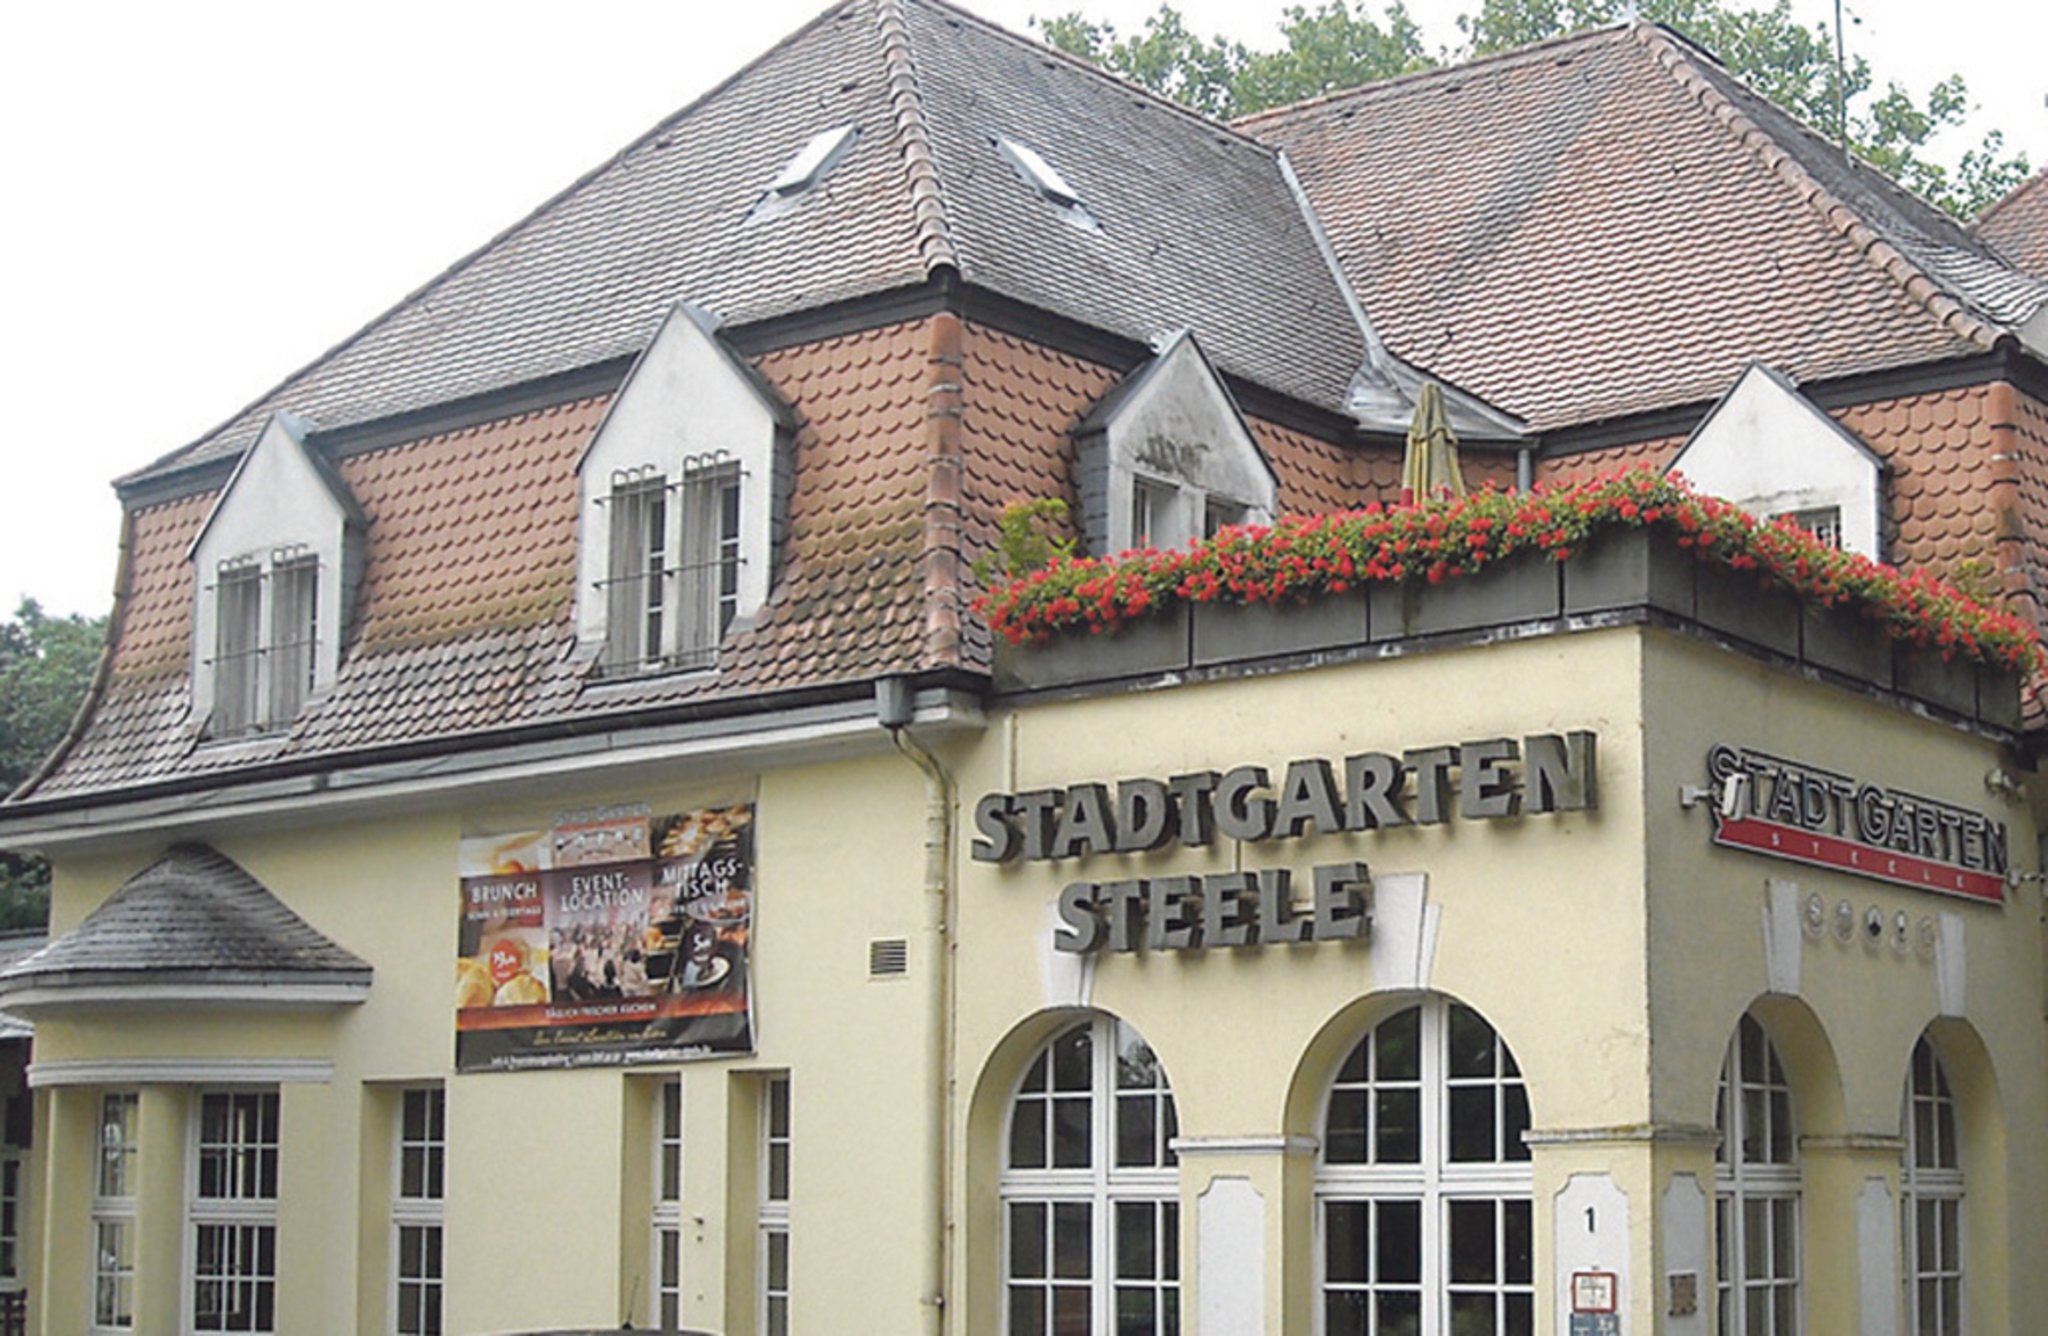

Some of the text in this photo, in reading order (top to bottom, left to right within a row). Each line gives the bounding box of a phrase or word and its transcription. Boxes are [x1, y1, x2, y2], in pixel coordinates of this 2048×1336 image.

[971, 730, 1596, 862] STADTGARTEN
[1772, 832, 1964, 888] STEELE
[471, 882, 538, 903] BRUNCH
[572, 872, 630, 895] EVENT-
[676, 877, 730, 898] TISCH
[560, 888, 644, 912] LOCATION
[1054, 861, 1374, 954] STEELE
[1585, 1206, 1595, 1233] 1
